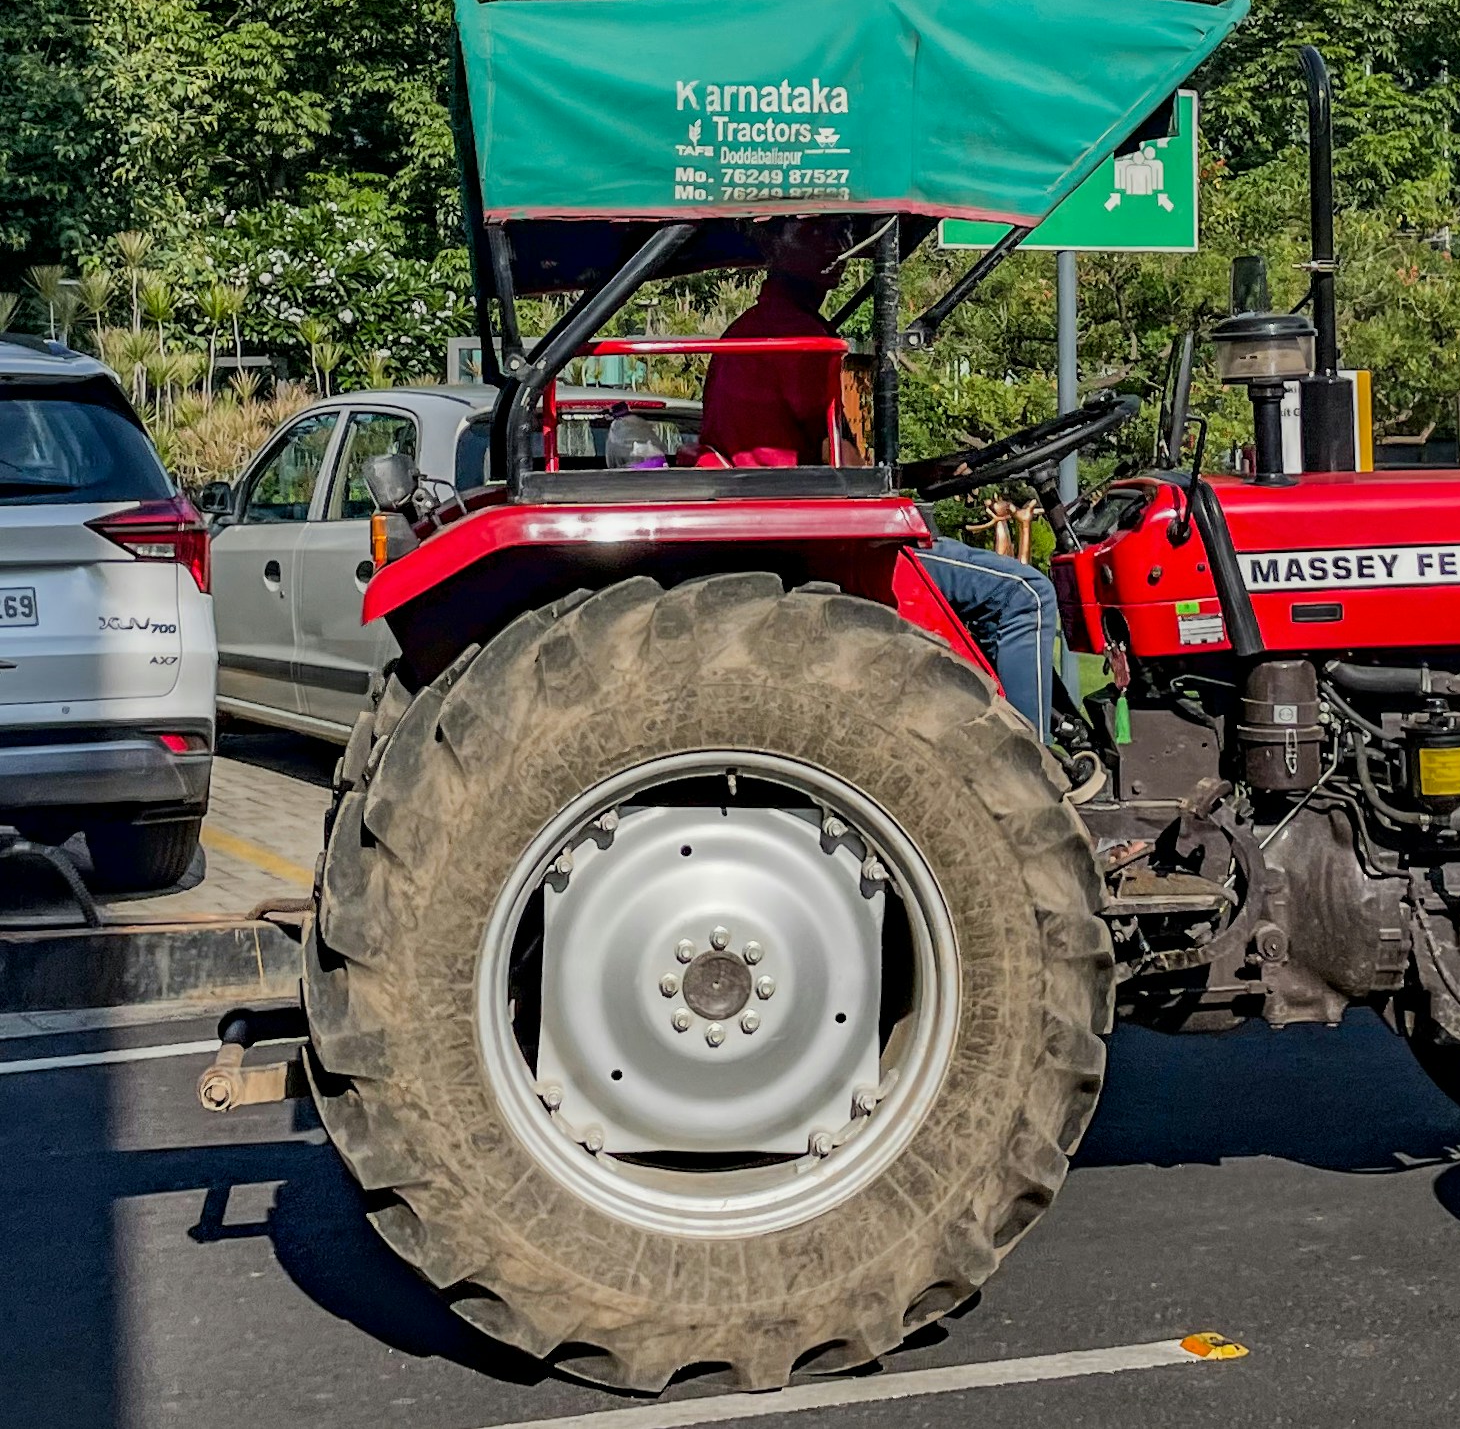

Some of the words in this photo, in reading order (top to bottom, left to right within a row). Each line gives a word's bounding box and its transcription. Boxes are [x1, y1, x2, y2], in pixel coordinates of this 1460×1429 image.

[712, 115, 812, 143] Tractors
[675, 144, 714, 157] TAFE
[675, 167, 714, 183] Mo.
[721, 169, 783, 184] 76249
[788, 169, 850, 184] 87527
[675, 185, 714, 201] Mo.
[1250, 554, 1399, 583] MASSEY
[0, 595, 33, 618] 69
[150, 656, 178, 666] AX7
